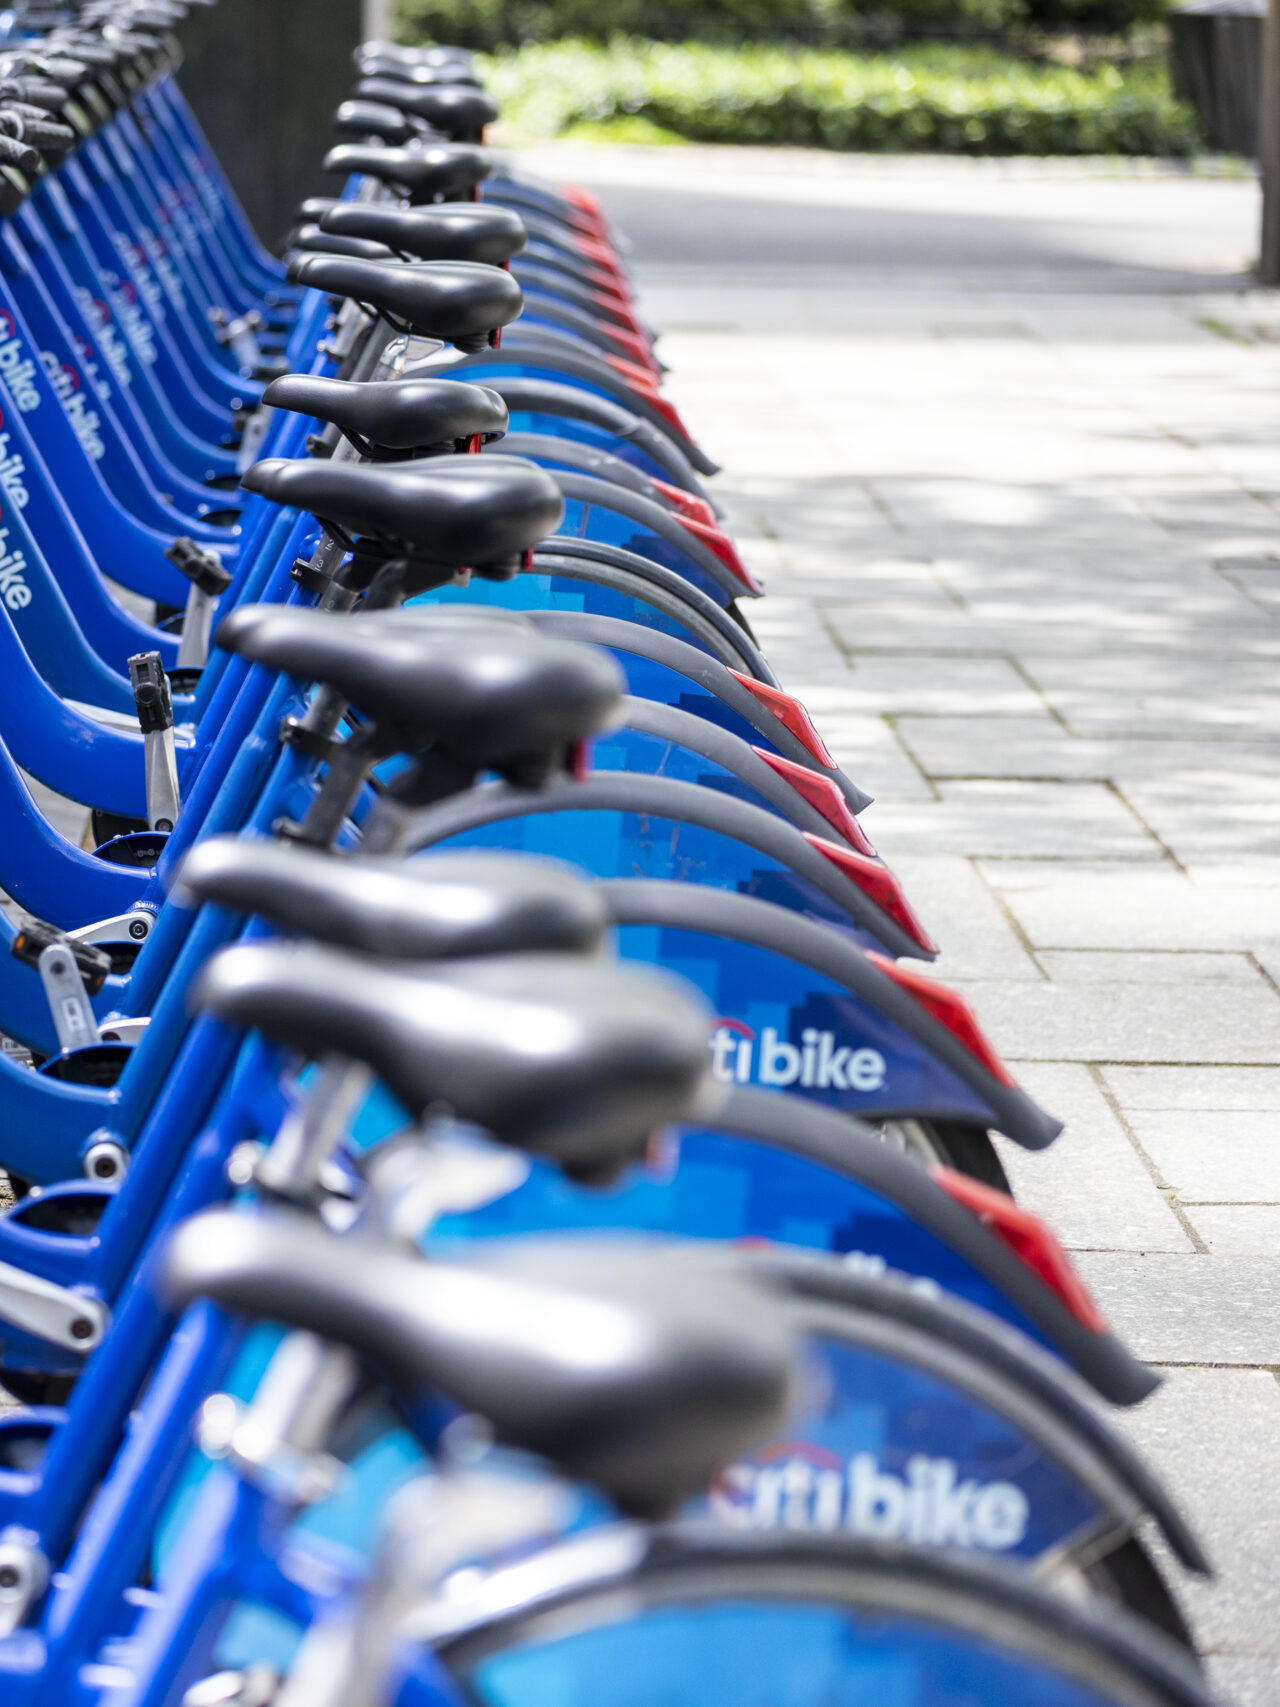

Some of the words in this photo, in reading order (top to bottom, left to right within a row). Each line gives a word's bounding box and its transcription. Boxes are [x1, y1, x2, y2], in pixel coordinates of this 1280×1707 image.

[707, 1017, 755, 1083] ti
[758, 1026, 887, 1092] bike
[848, 1450, 1030, 1550] bike
